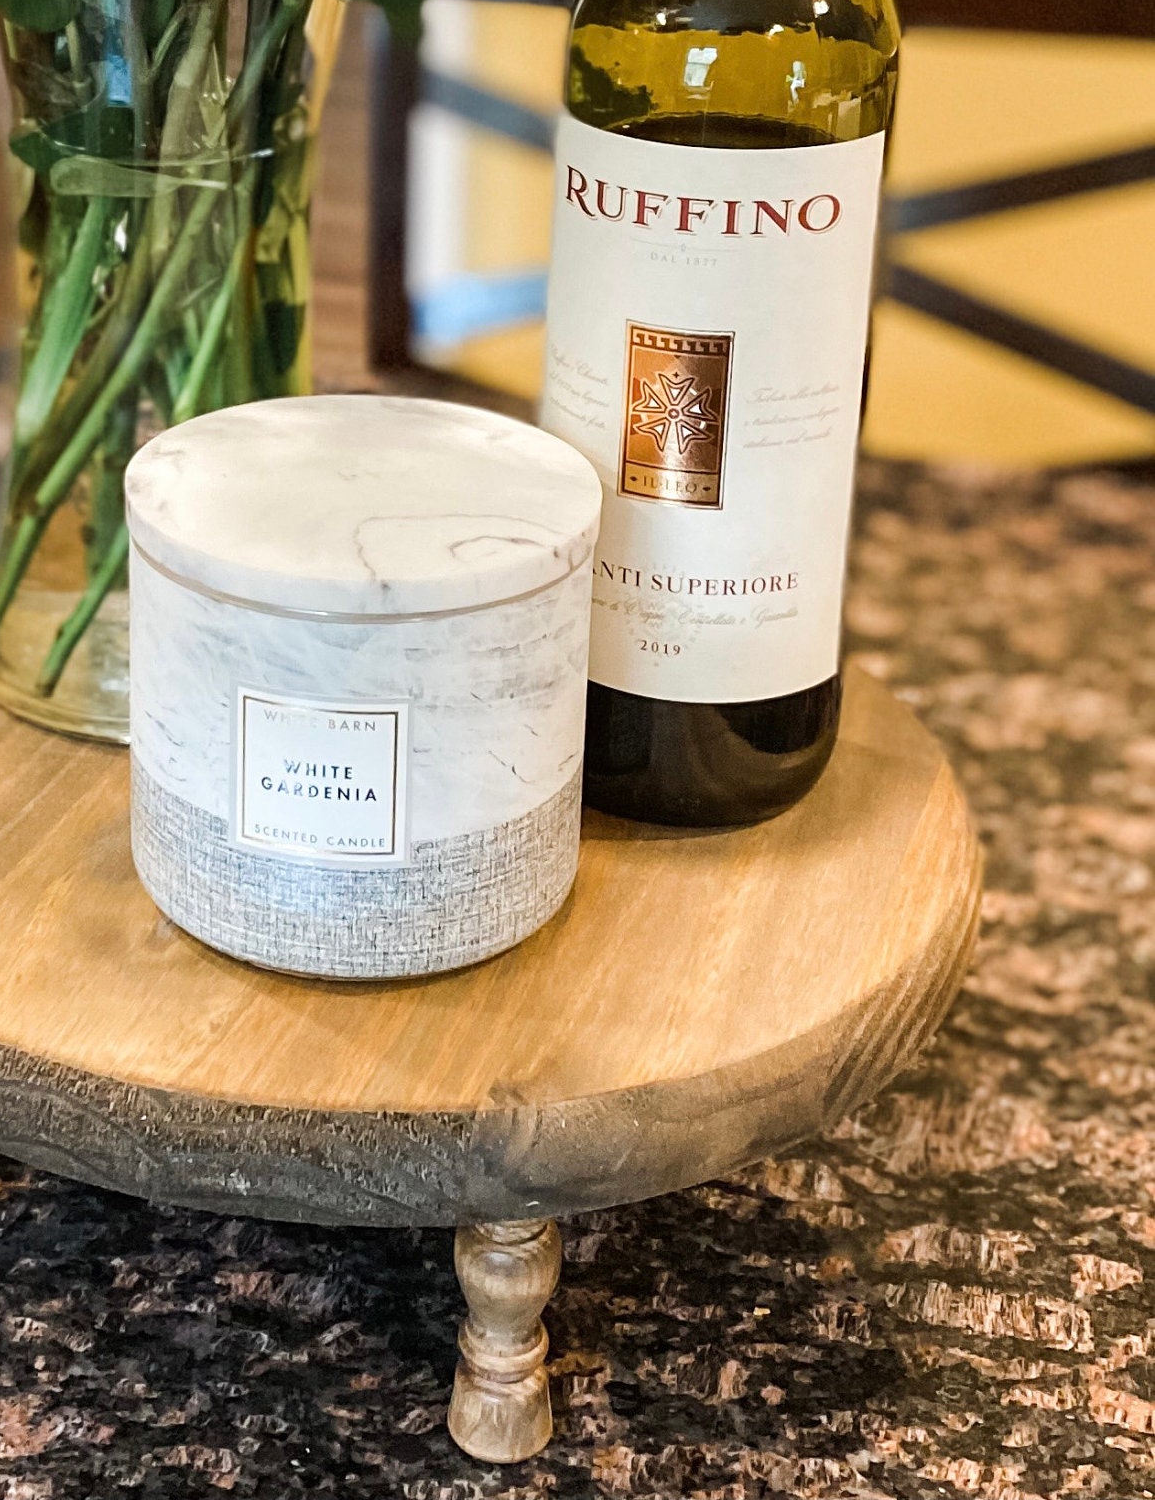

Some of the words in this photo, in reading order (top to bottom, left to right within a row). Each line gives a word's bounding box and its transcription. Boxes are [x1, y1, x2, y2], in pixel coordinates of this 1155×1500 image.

[565, 164, 843, 236] RUFFINO
[650, 251, 677, 264] DAL
[592, 560, 641, 588] NTI
[650, 571, 799, 596] SUPERIORE
[639, 639, 681, 655] 2019
[328, 718, 376, 732] BARN
[283, 758, 353, 780] WHITE
[261, 776, 377, 802] GARDENIA
[254, 823, 318, 844] SCENTED
[326, 836, 386, 848] CANDLE
